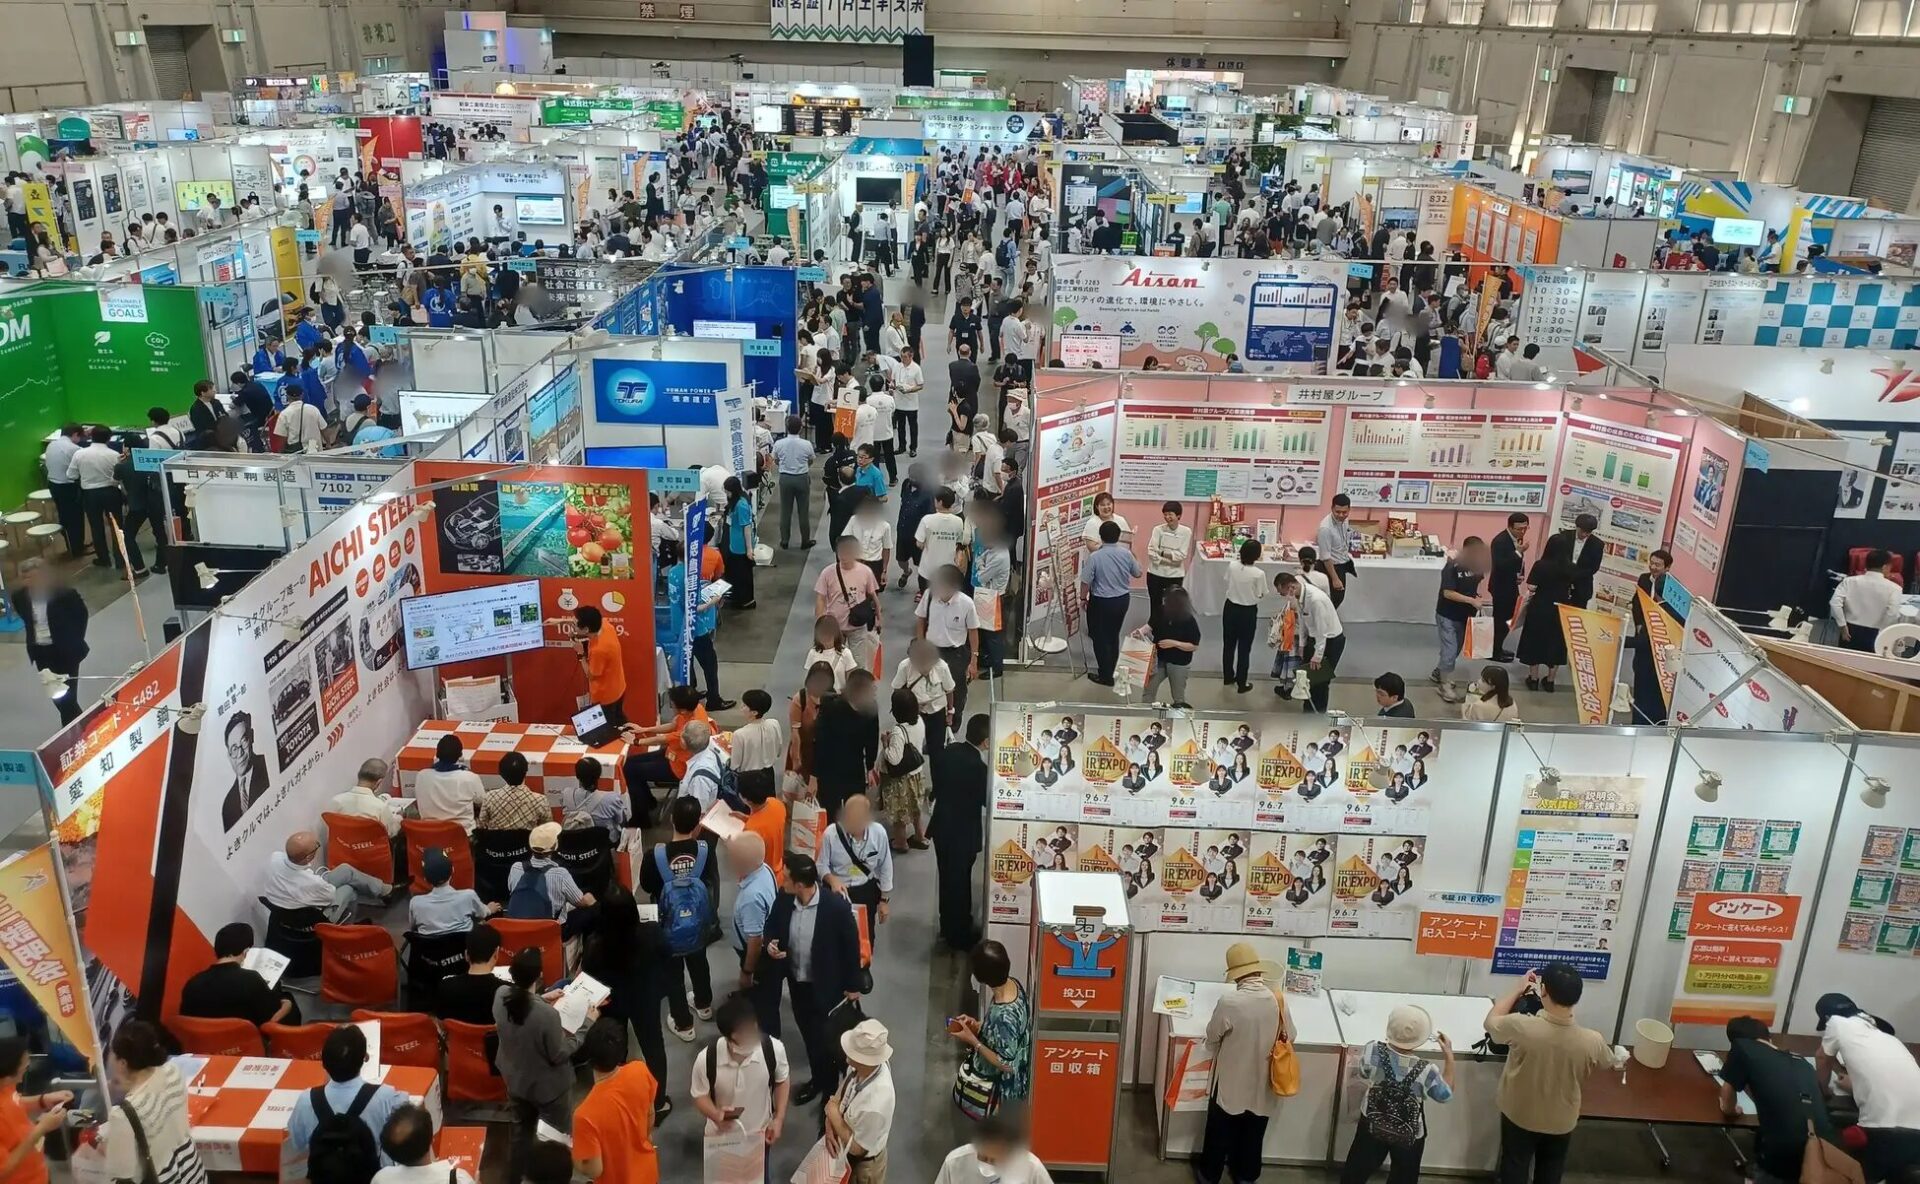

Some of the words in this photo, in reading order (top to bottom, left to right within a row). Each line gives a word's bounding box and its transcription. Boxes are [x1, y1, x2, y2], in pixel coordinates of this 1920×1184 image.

[1119, 268, 1199, 288] Aisan
[109, 308, 144, 318] GOALS
[1298, 388, 1384, 401] 井村屋グループ
[320, 483, 353, 494] 7102
[309, 525, 364, 598] AICHI
[285, 723, 312, 754] TOYOTA
[68, 704, 170, 806] 愛知製鋼
[1470, 896, 1495, 904] EXPO
[1715, 902, 1776, 916] アンケート
[1430, 917, 1487, 930] アンケート
[1422, 928, 1492, 941] 記入コーナー
[1063, 988, 1096, 999] 投入口
[1043, 1047, 1109, 1060] アンケート
[1050, 1062, 1101, 1076] 回収箱
